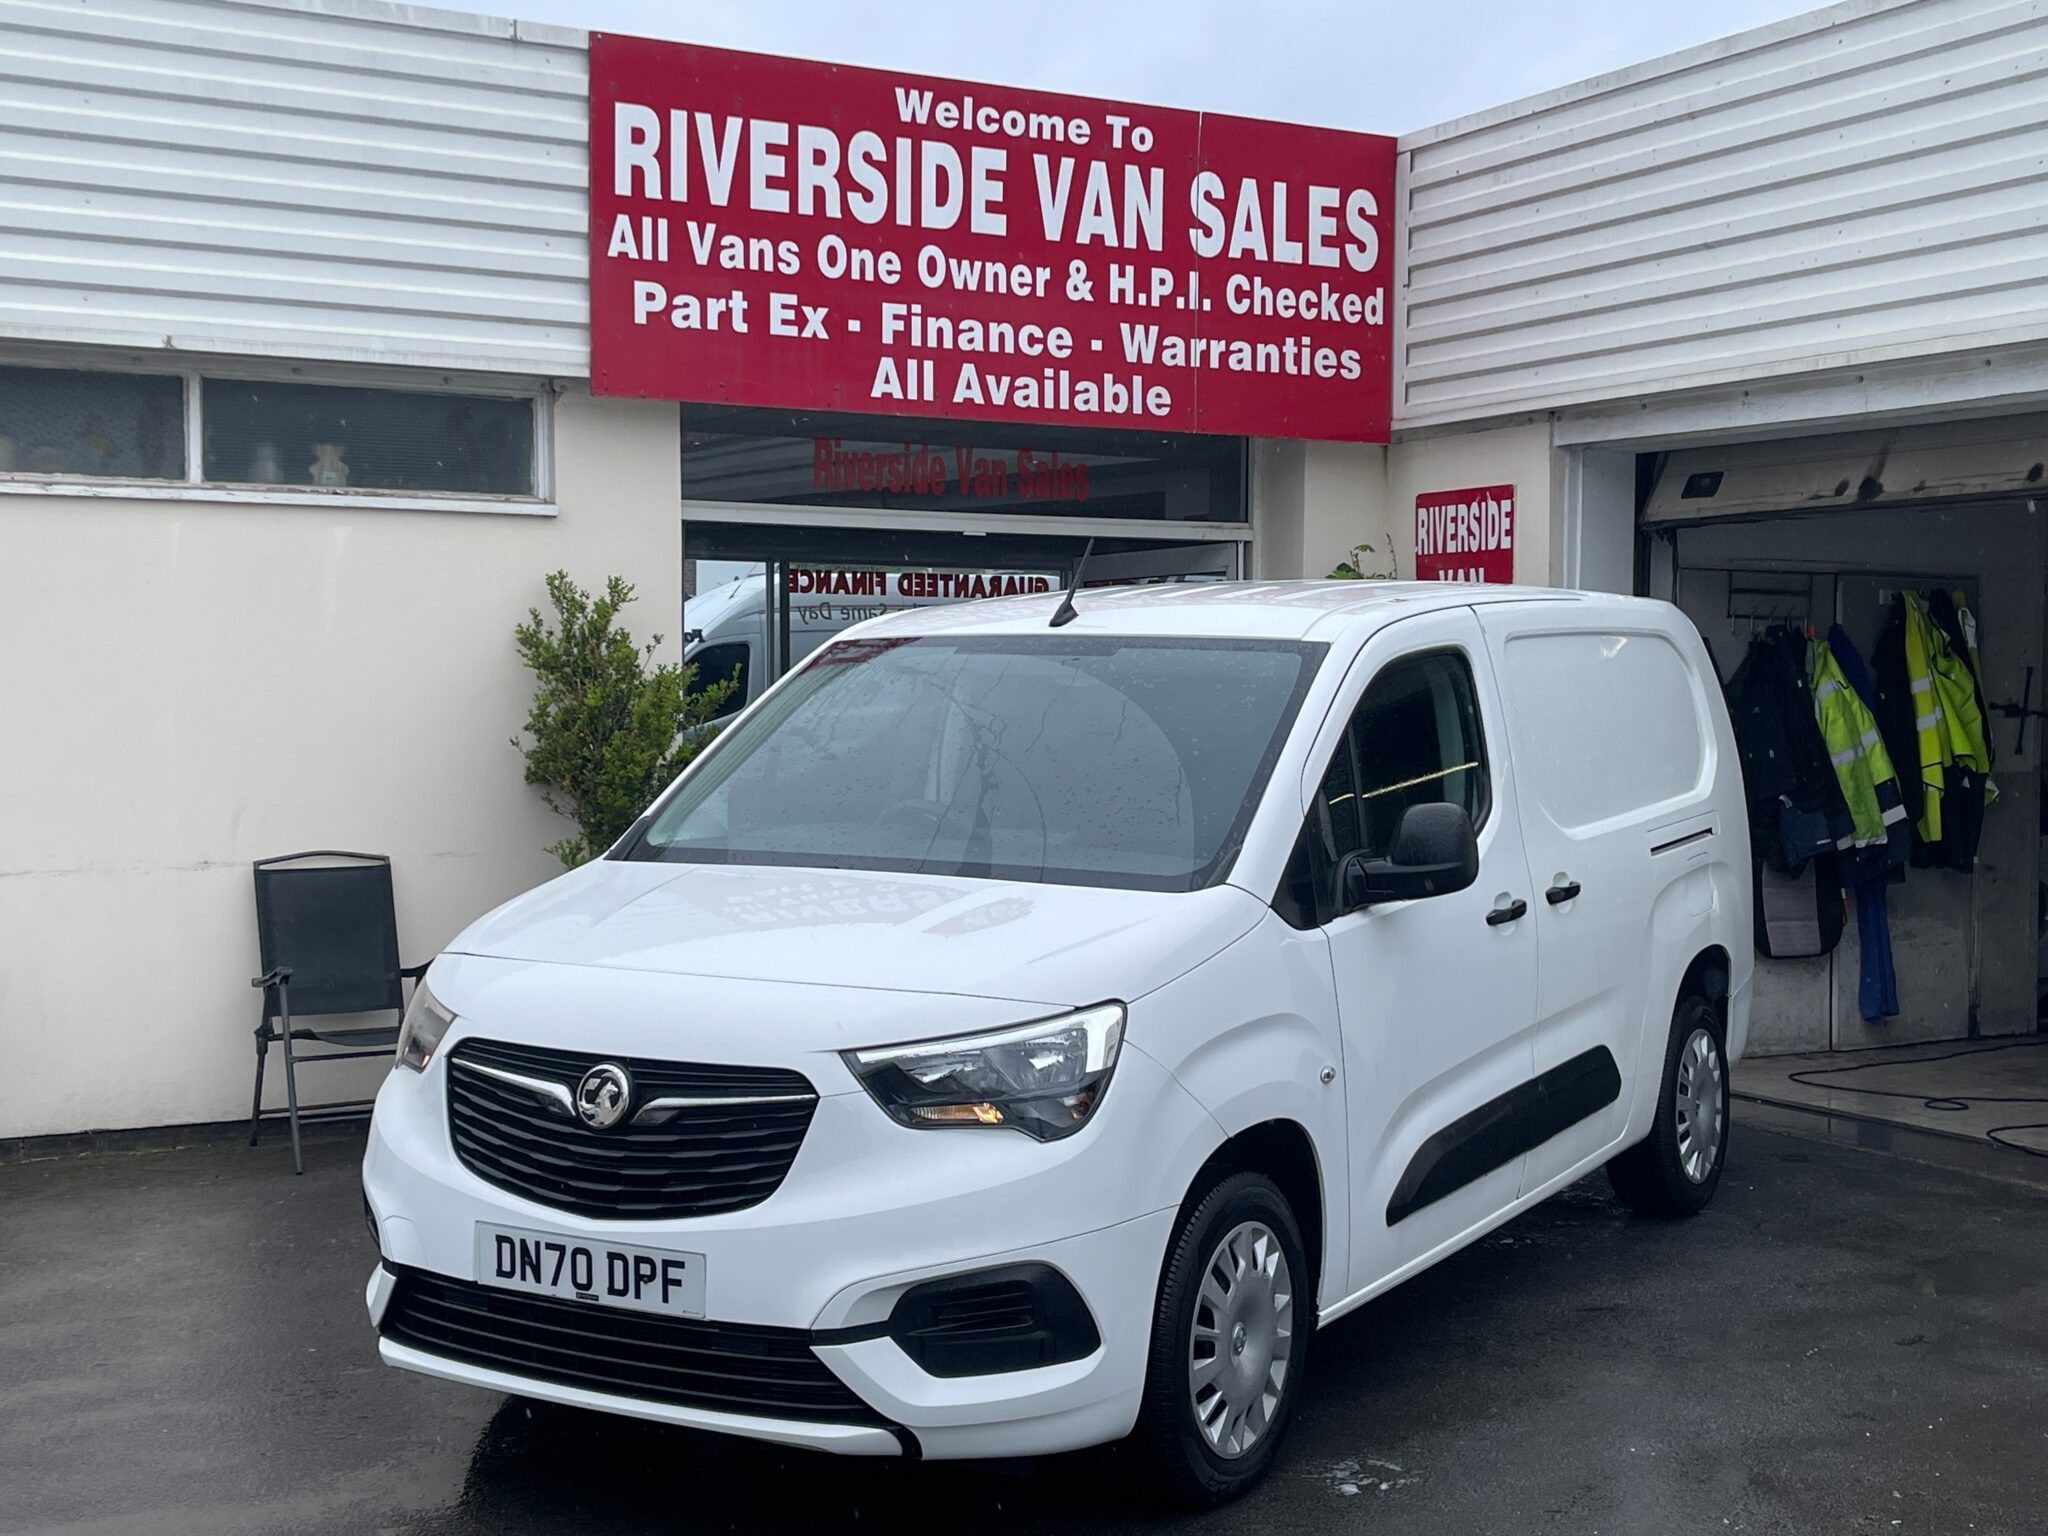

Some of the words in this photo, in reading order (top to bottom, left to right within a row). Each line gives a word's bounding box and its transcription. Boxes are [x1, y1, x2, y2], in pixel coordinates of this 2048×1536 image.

[894, 86, 1091, 145] Welcome
[1105, 114, 1154, 153] To
[614, 101, 1008, 237] RIVERSIDE
[1032, 153, 1164, 252] VAN
[1188, 171, 1379, 273] SALES
[607, 213, 669, 262] All
[687, 220, 801, 275] Vans
[817, 234, 901, 285] One
[917, 244, 1051, 298] Owner
[1065, 259, 1094, 302] &
[1109, 263, 1212, 312] H.P.I.
[1226, 273, 1384, 325] Checked
[633, 279, 749, 334] Part
[769, 292, 830, 340] Ex
[881, 302, 1073, 359] Finance
[1119, 322, 1362, 380] Warranties
[870, 356, 934, 402] All
[952, 362, 1172, 416] Available
[813, 436, 946, 495] Riverside
[955, 444, 1008, 496] Van
[1016, 448, 1090, 501] Sales
[1417, 499, 1512, 556] RIVERSIDE
[495, 1234, 593, 1291] DN70
[606, 1251, 686, 1304] DPF
